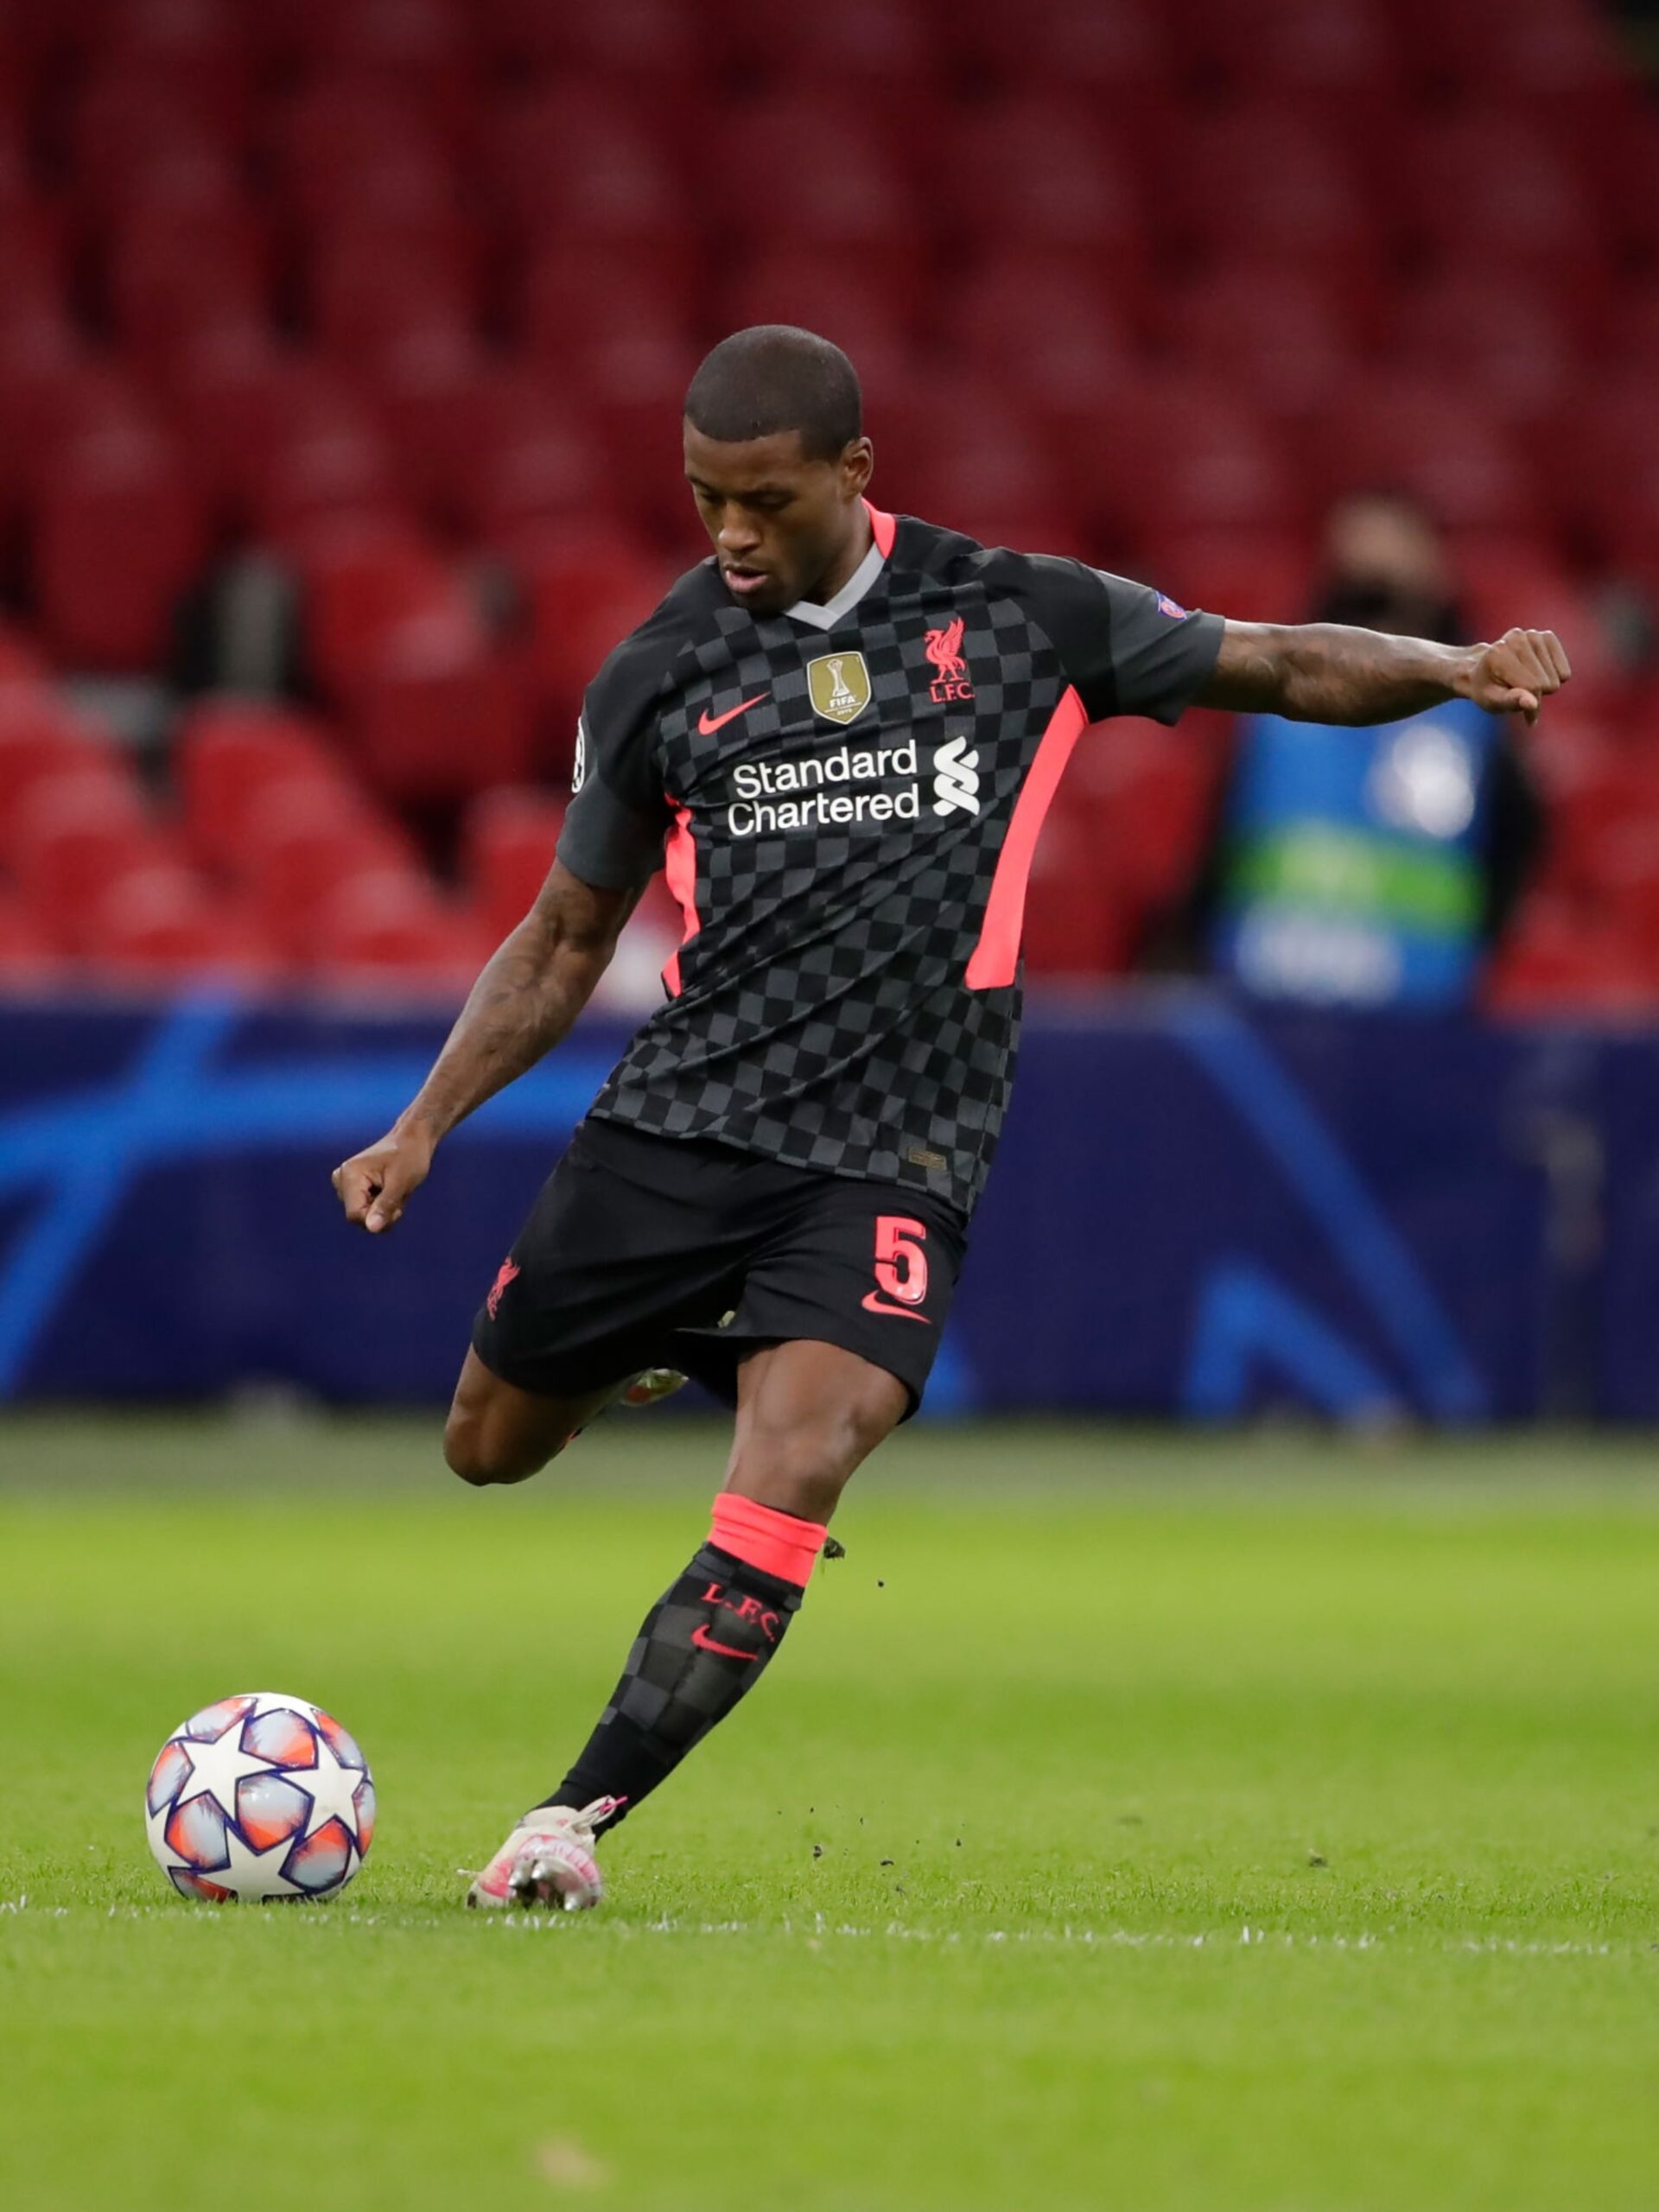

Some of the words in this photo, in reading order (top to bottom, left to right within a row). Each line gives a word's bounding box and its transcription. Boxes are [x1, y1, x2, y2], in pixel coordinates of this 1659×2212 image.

[830, 695, 855, 708] FIFA
[733, 739, 918, 799] Standard
[728, 783, 920, 836] Chartered
[874, 1216, 928, 1306] 5
